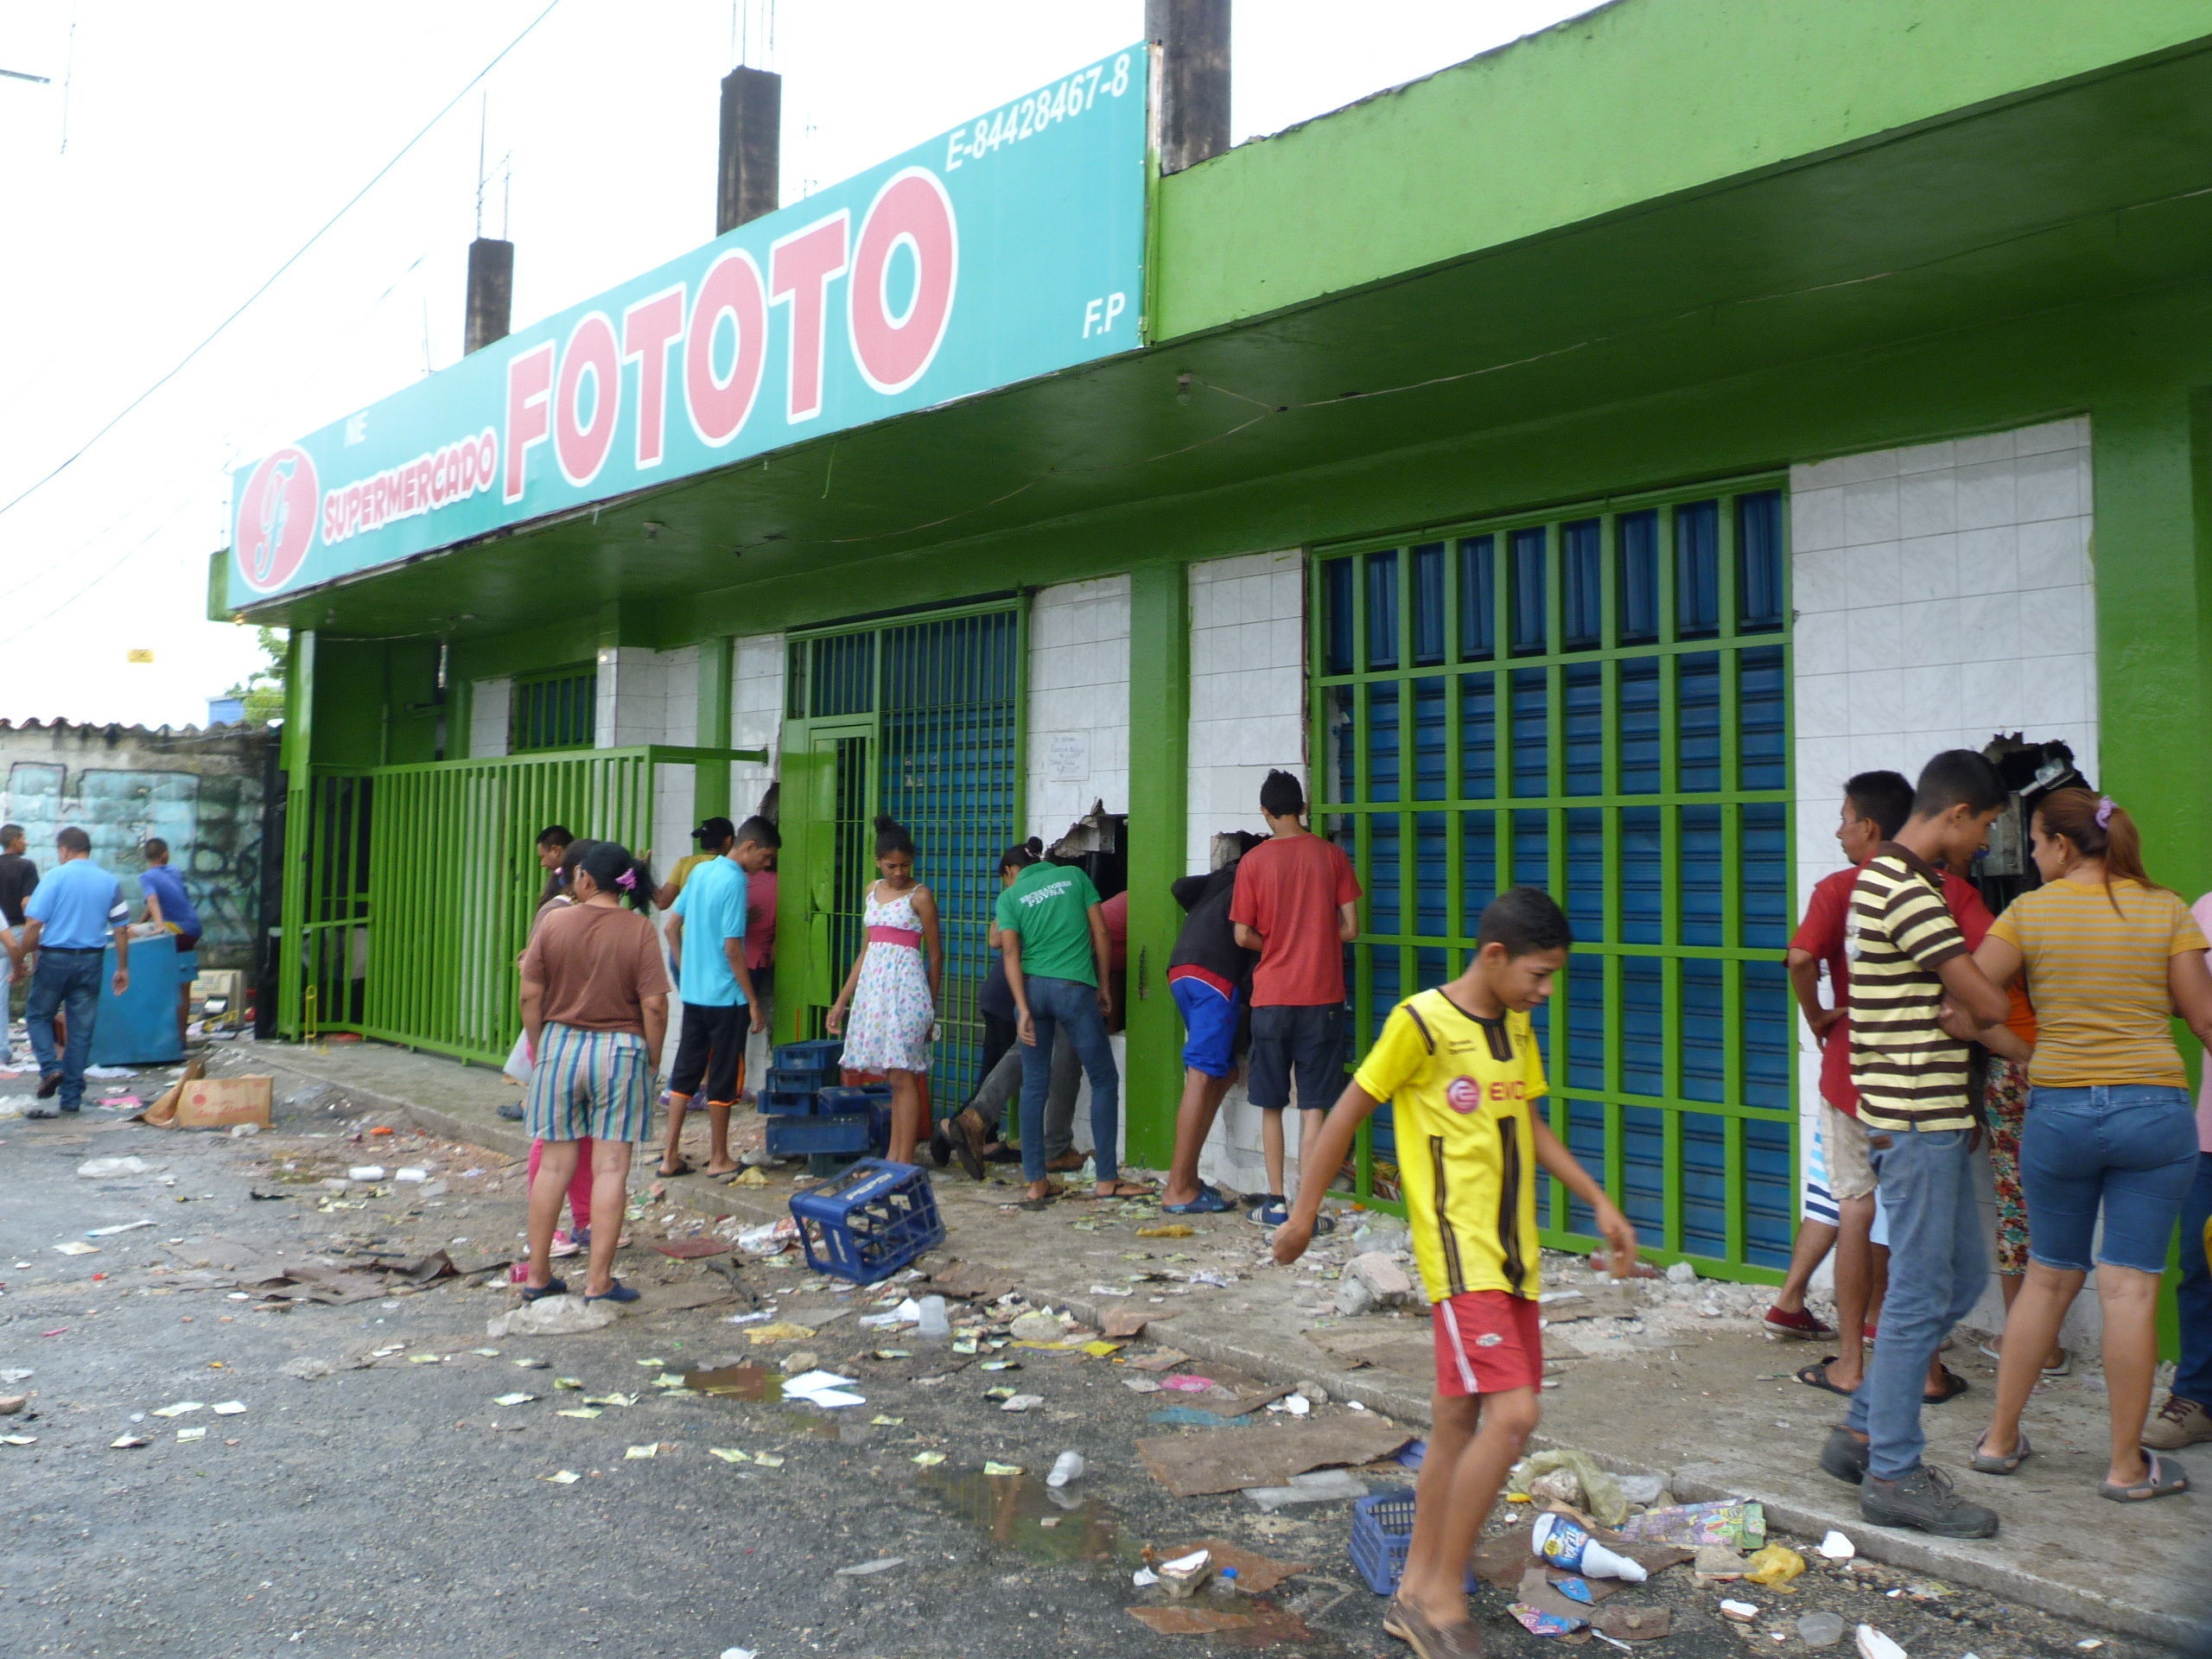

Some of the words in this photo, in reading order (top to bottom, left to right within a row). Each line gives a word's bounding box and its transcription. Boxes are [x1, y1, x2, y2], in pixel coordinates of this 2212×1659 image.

[944, 53, 1132, 173] E-84428467-8
[321, 428, 498, 545] SUPERMERCADO
[504, 167, 958, 504] FOTOTO
[1082, 291, 1125, 339] F.P
[1028, 887, 1065, 907] PDVSA
